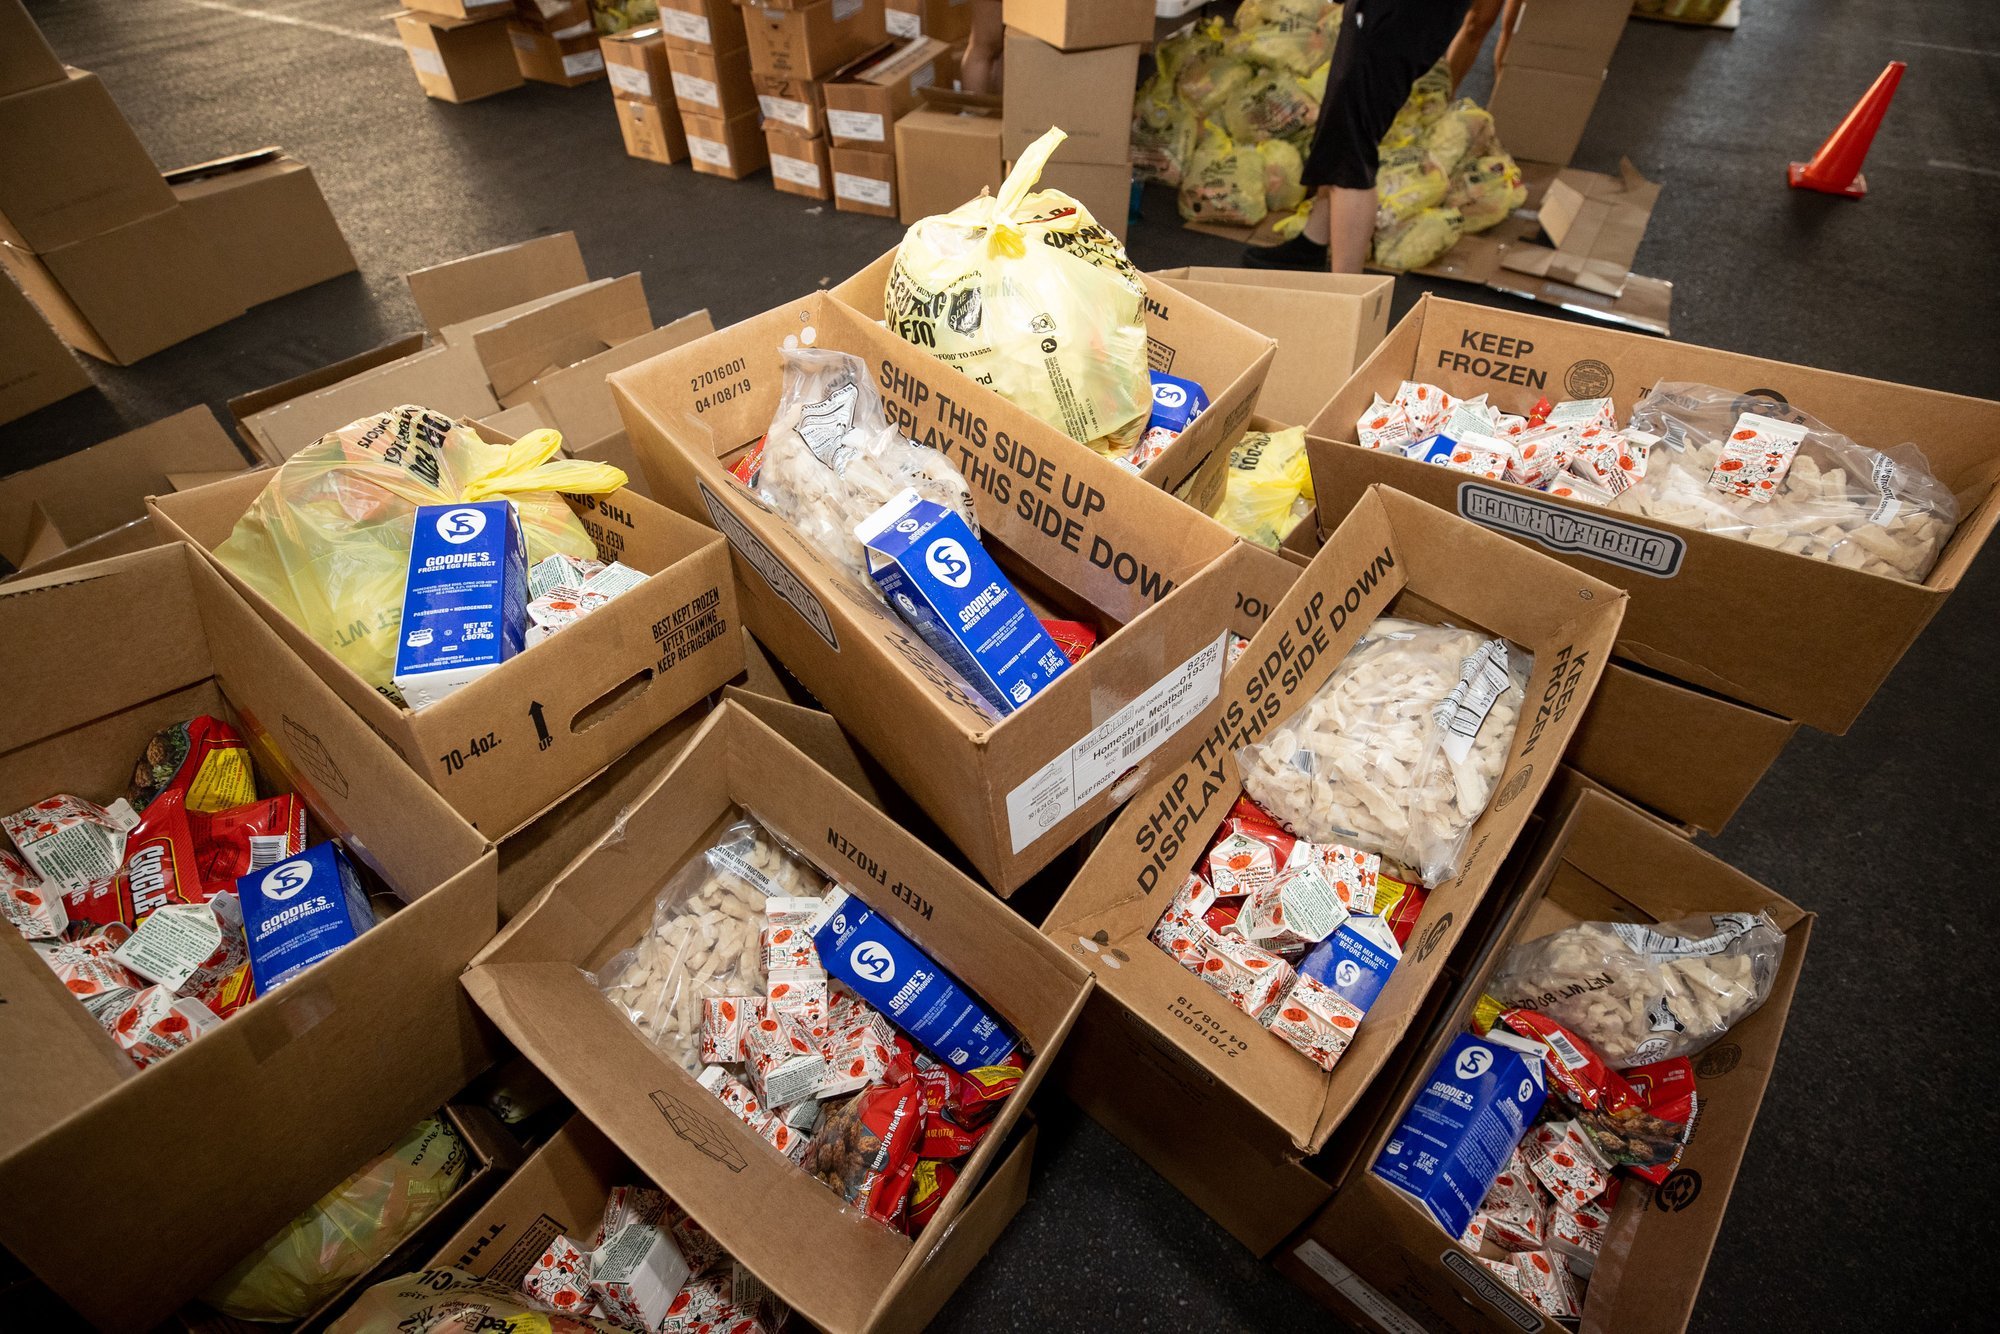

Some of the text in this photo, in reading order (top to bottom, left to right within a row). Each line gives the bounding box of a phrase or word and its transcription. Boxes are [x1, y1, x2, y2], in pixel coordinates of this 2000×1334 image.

[1460, 329, 1534, 360] KEEP
[691, 358, 747, 392] 27016001
[1438, 350, 1548, 390] FROZEN
[696, 379, 751, 413] 04/08/19
[880, 360, 928, 408] SHIP
[936, 392, 988, 448] THIS
[993, 432, 1056, 493] SIDE
[1062, 474, 1105, 518] UP
[599, 500, 634, 529] THIS
[960, 446, 1012, 504] THIS
[1016, 490, 1086, 553] SIDE
[1090, 536, 1178, 602] DOW
[1473, 495, 1666, 567] CIRCLE A RANCH
[426, 552, 490, 567] GOODIE'S
[606, 529, 625, 552] KEEP
[418, 564, 444, 574] FROZEN
[462, 560, 496, 568] PRODUCT
[414, 604, 492, 618] PASTEURIZED HOMOGENIZED
[652, 586, 720, 640] BEST KEPT FROZEN
[958, 582, 1002, 623] GOODIE'S
[962, 614, 980, 634] FROZEN
[980, 606, 990, 617] EGG
[988, 588, 1010, 610] PRODUCT
[462, 633, 494, 642] (.907kg)
[463, 622, 478, 630] NET
[662, 608, 717, 652] AFTER THAWING
[656, 620, 727, 674] KEEP REFRIGERATED
[1038, 656, 1048, 667] NET
[1187, 642, 1218, 672] 82260
[1520, 644, 1574, 758] FROZEN
[1553, 650, 1590, 723] KEEP
[1093, 718, 1144, 761] Homestyle
[1148, 682, 1193, 718] Meatballs
[1135, 591, 1324, 854] SHIP THIS SIDE UP
[1136, 758, 1226, 896] DISPLAY
[1228, 692, 1280, 752] THIS
[1282, 625, 1330, 696] SIDE
[1328, 546, 1395, 633] DOWN
[538, 736, 554, 752] UP
[1077, 769, 1116, 801] KEEP FROZEN
[130, 845, 168, 914] CIRCLE
[735, 854, 770, 885] INSTRUCTIONS
[827, 826, 934, 922] KEEP FROZEN
[256, 902, 335, 942] FROZEN EGG PRODUCT
[261, 895, 326, 933] GOODIE'S
[1335, 929, 1389, 970] SHAKE OR MIX WELL
[1339, 940, 1379, 971] BEFORE USING
[888, 970, 928, 1010] GOODIE'S
[892, 997, 910, 1018] FROZEN
[908, 991, 918, 1004] EGG
[916, 972, 935, 996] PRODUCT
[1536, 990, 1558, 1008] 80
[1583, 971, 1615, 991] NET
[972, 1014, 990, 1034] NET WT.
[983, 1020, 994, 1032] LBS.
[1166, 1004, 1238, 1058] 27016001
[1176, 996, 1248, 1050] 04/08/19
[1432, 1081, 1473, 1104] GOODIE'S
[411, 1155, 423, 1166] TO
